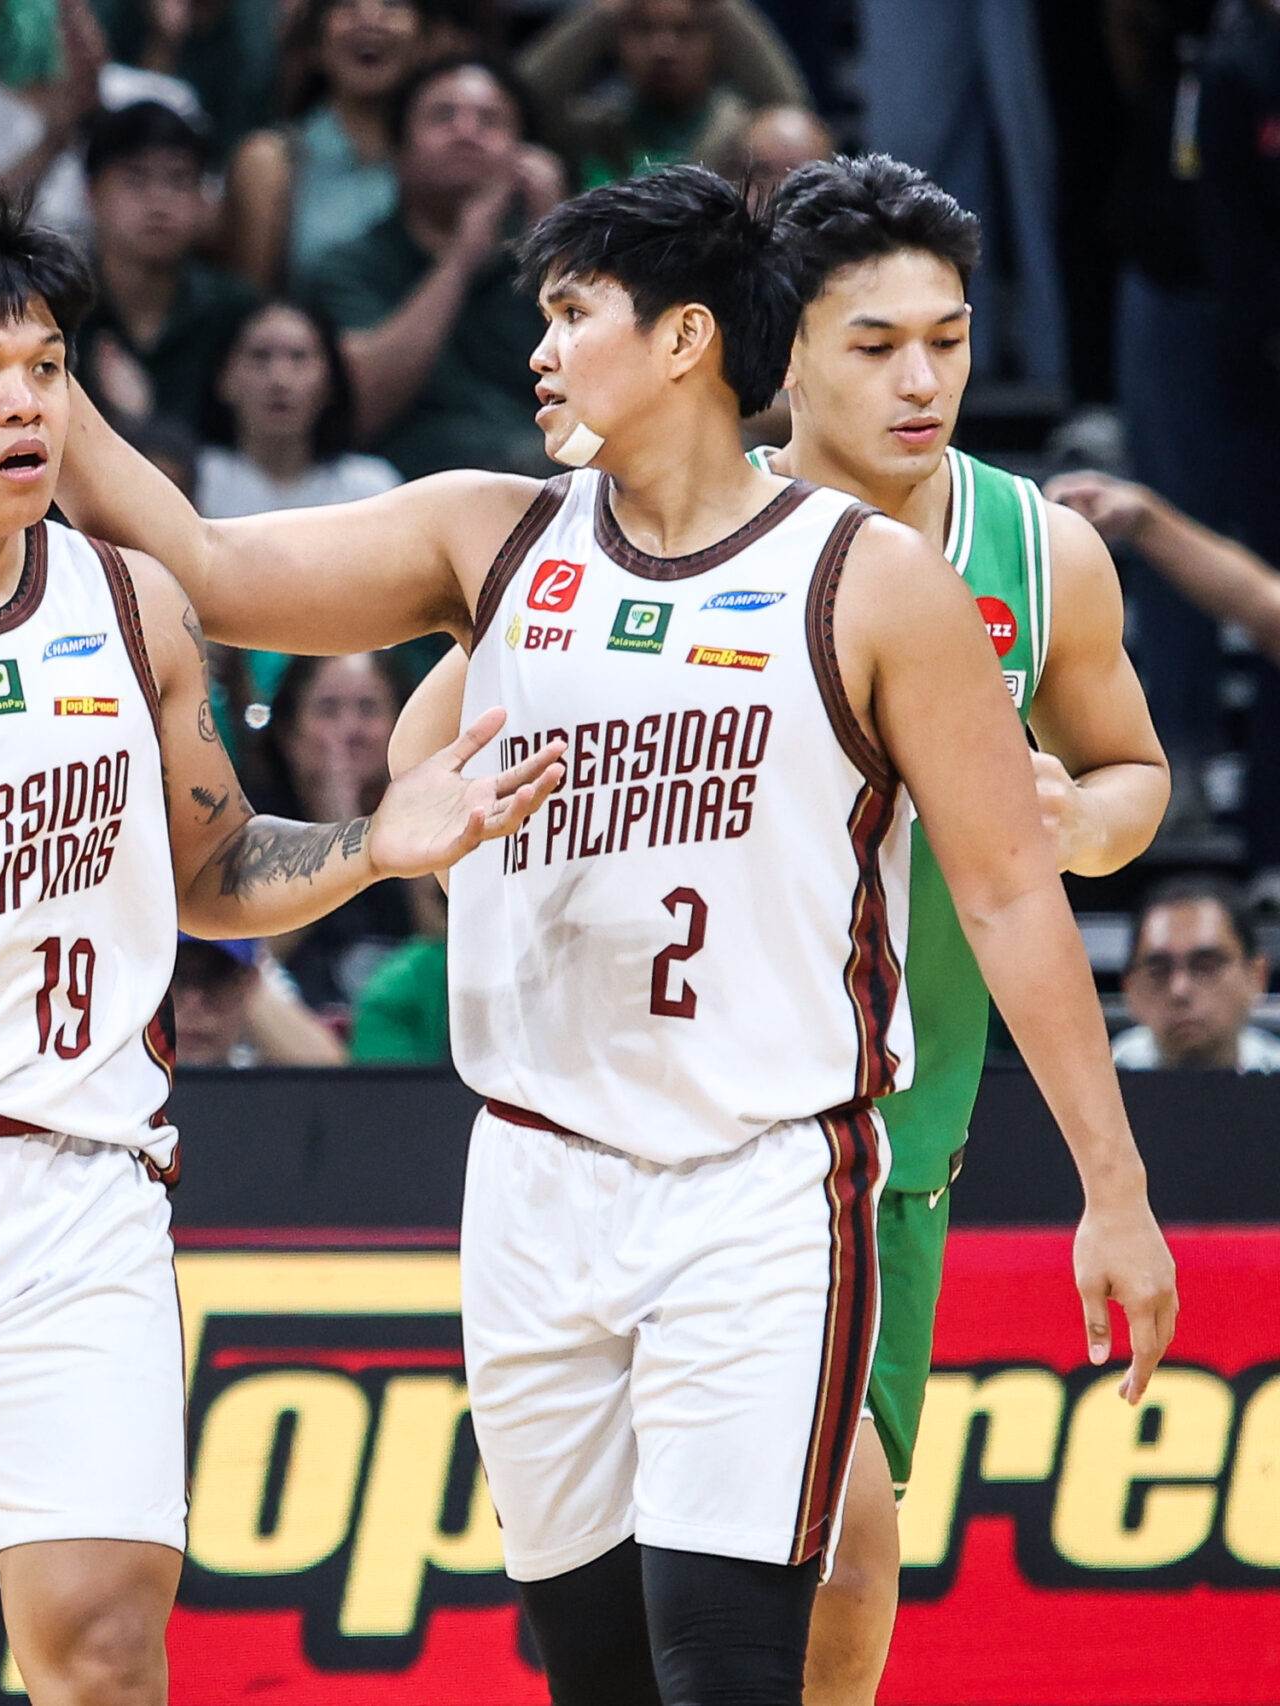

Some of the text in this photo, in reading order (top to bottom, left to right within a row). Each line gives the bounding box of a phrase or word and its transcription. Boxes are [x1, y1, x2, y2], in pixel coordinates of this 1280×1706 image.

[707, 592, 782, 608] CHAMPION
[524, 625, 574, 651] BPI
[985, 623, 1012, 637] zz
[45, 635, 106, 657] CHAMPION
[608, 636, 663, 651] PalawanPay
[691, 645, 769, 668] TopBreed
[54, 696, 118, 717] TopBreed
[544, 774, 757, 866] PILIPINAS
[649, 886, 708, 1020] 2
[32, 936, 96, 1060] 19
